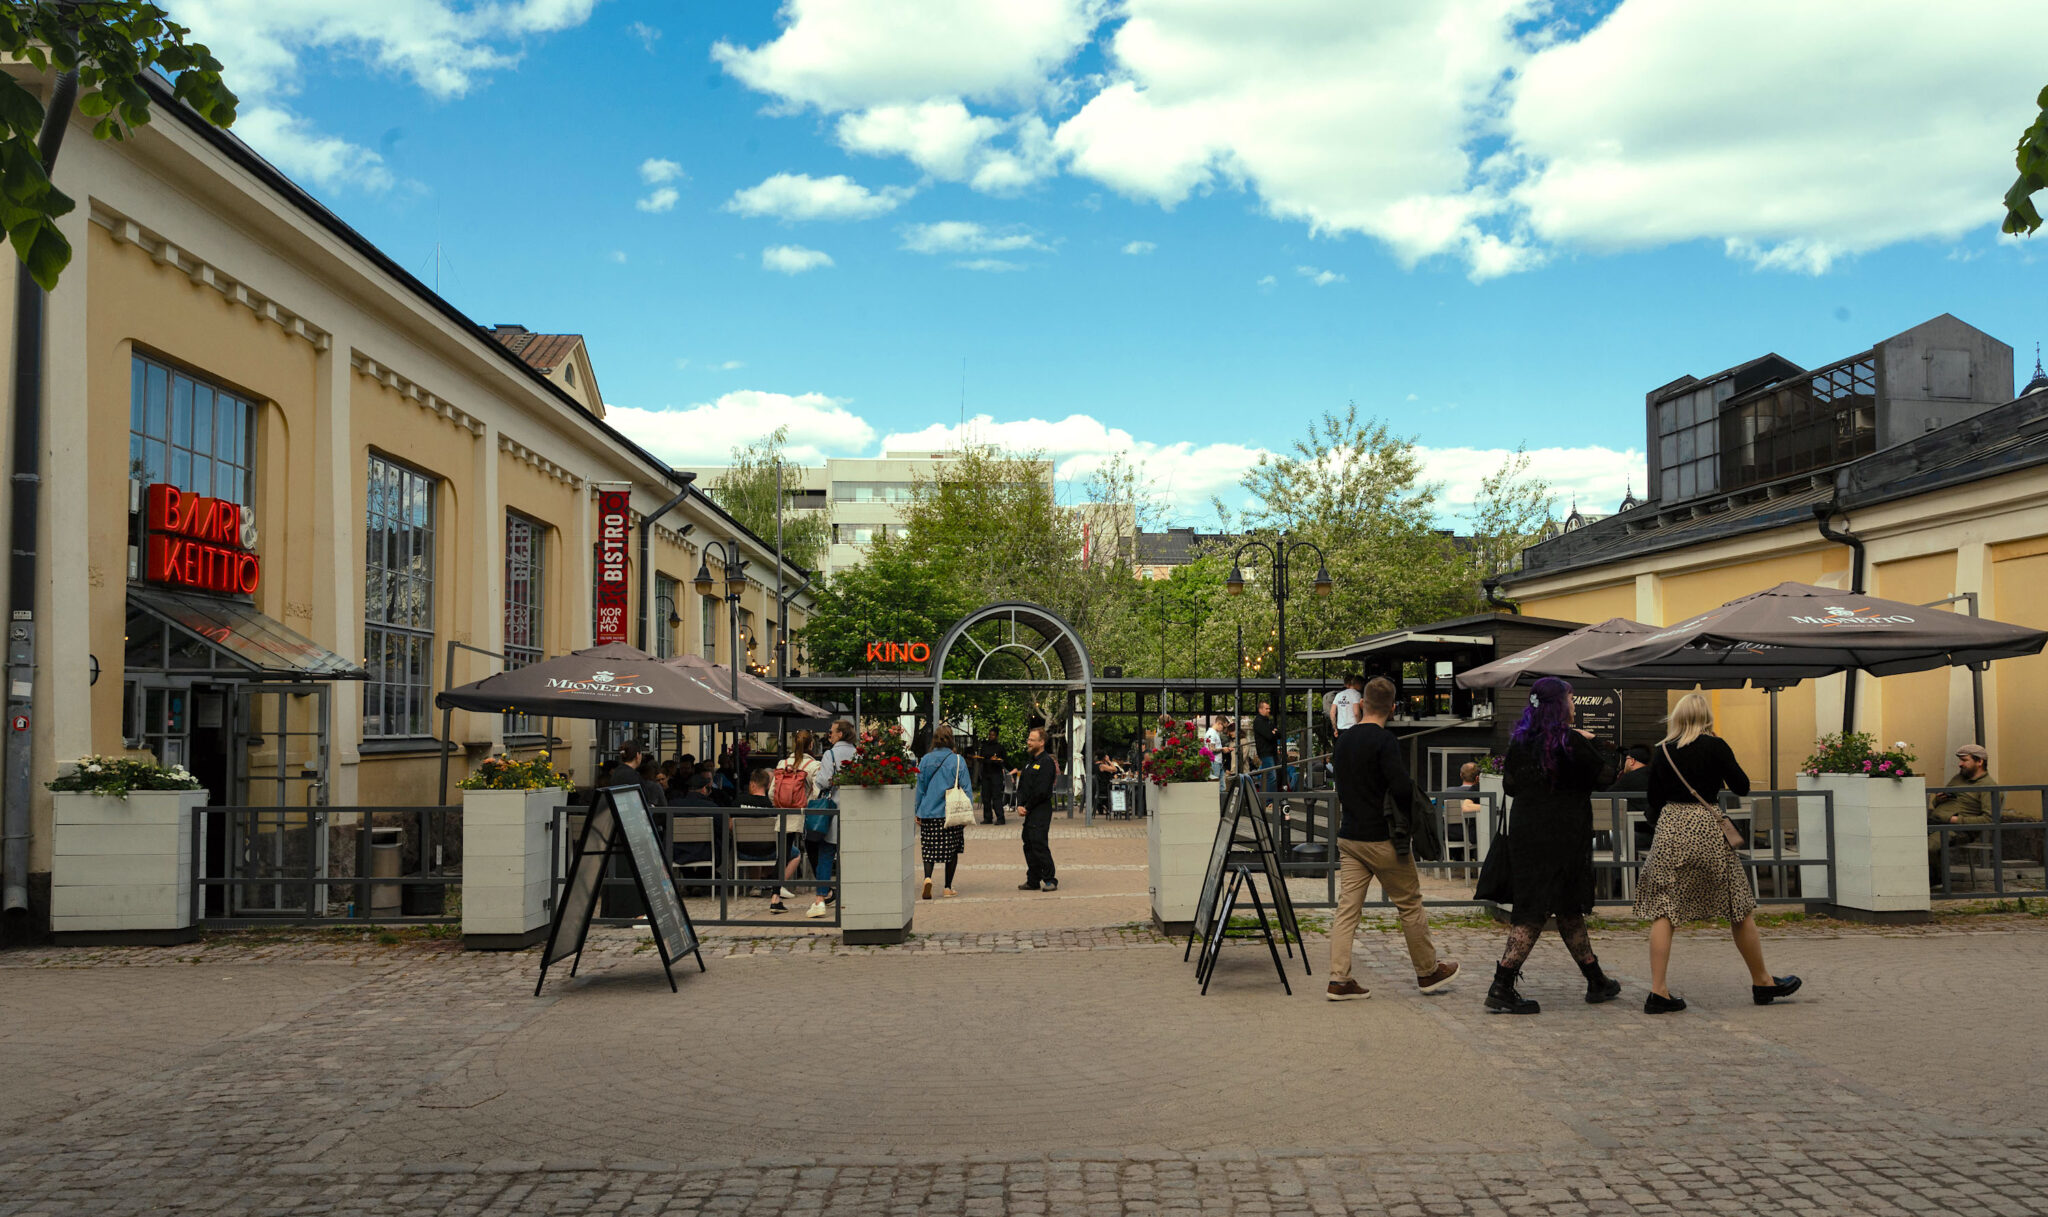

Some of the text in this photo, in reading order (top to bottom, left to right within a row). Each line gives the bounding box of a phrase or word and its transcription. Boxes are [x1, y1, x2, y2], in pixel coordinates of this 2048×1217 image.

[164, 486, 258, 549] BAARI &
[604, 514, 624, 582] BISTRO
[600, 607, 622, 616] KOR
[600, 616, 619, 624] JAA
[600, 624, 617, 632] MO
[867, 641, 930, 662] KINO
[1572, 695, 1603, 706] ZAMENU
